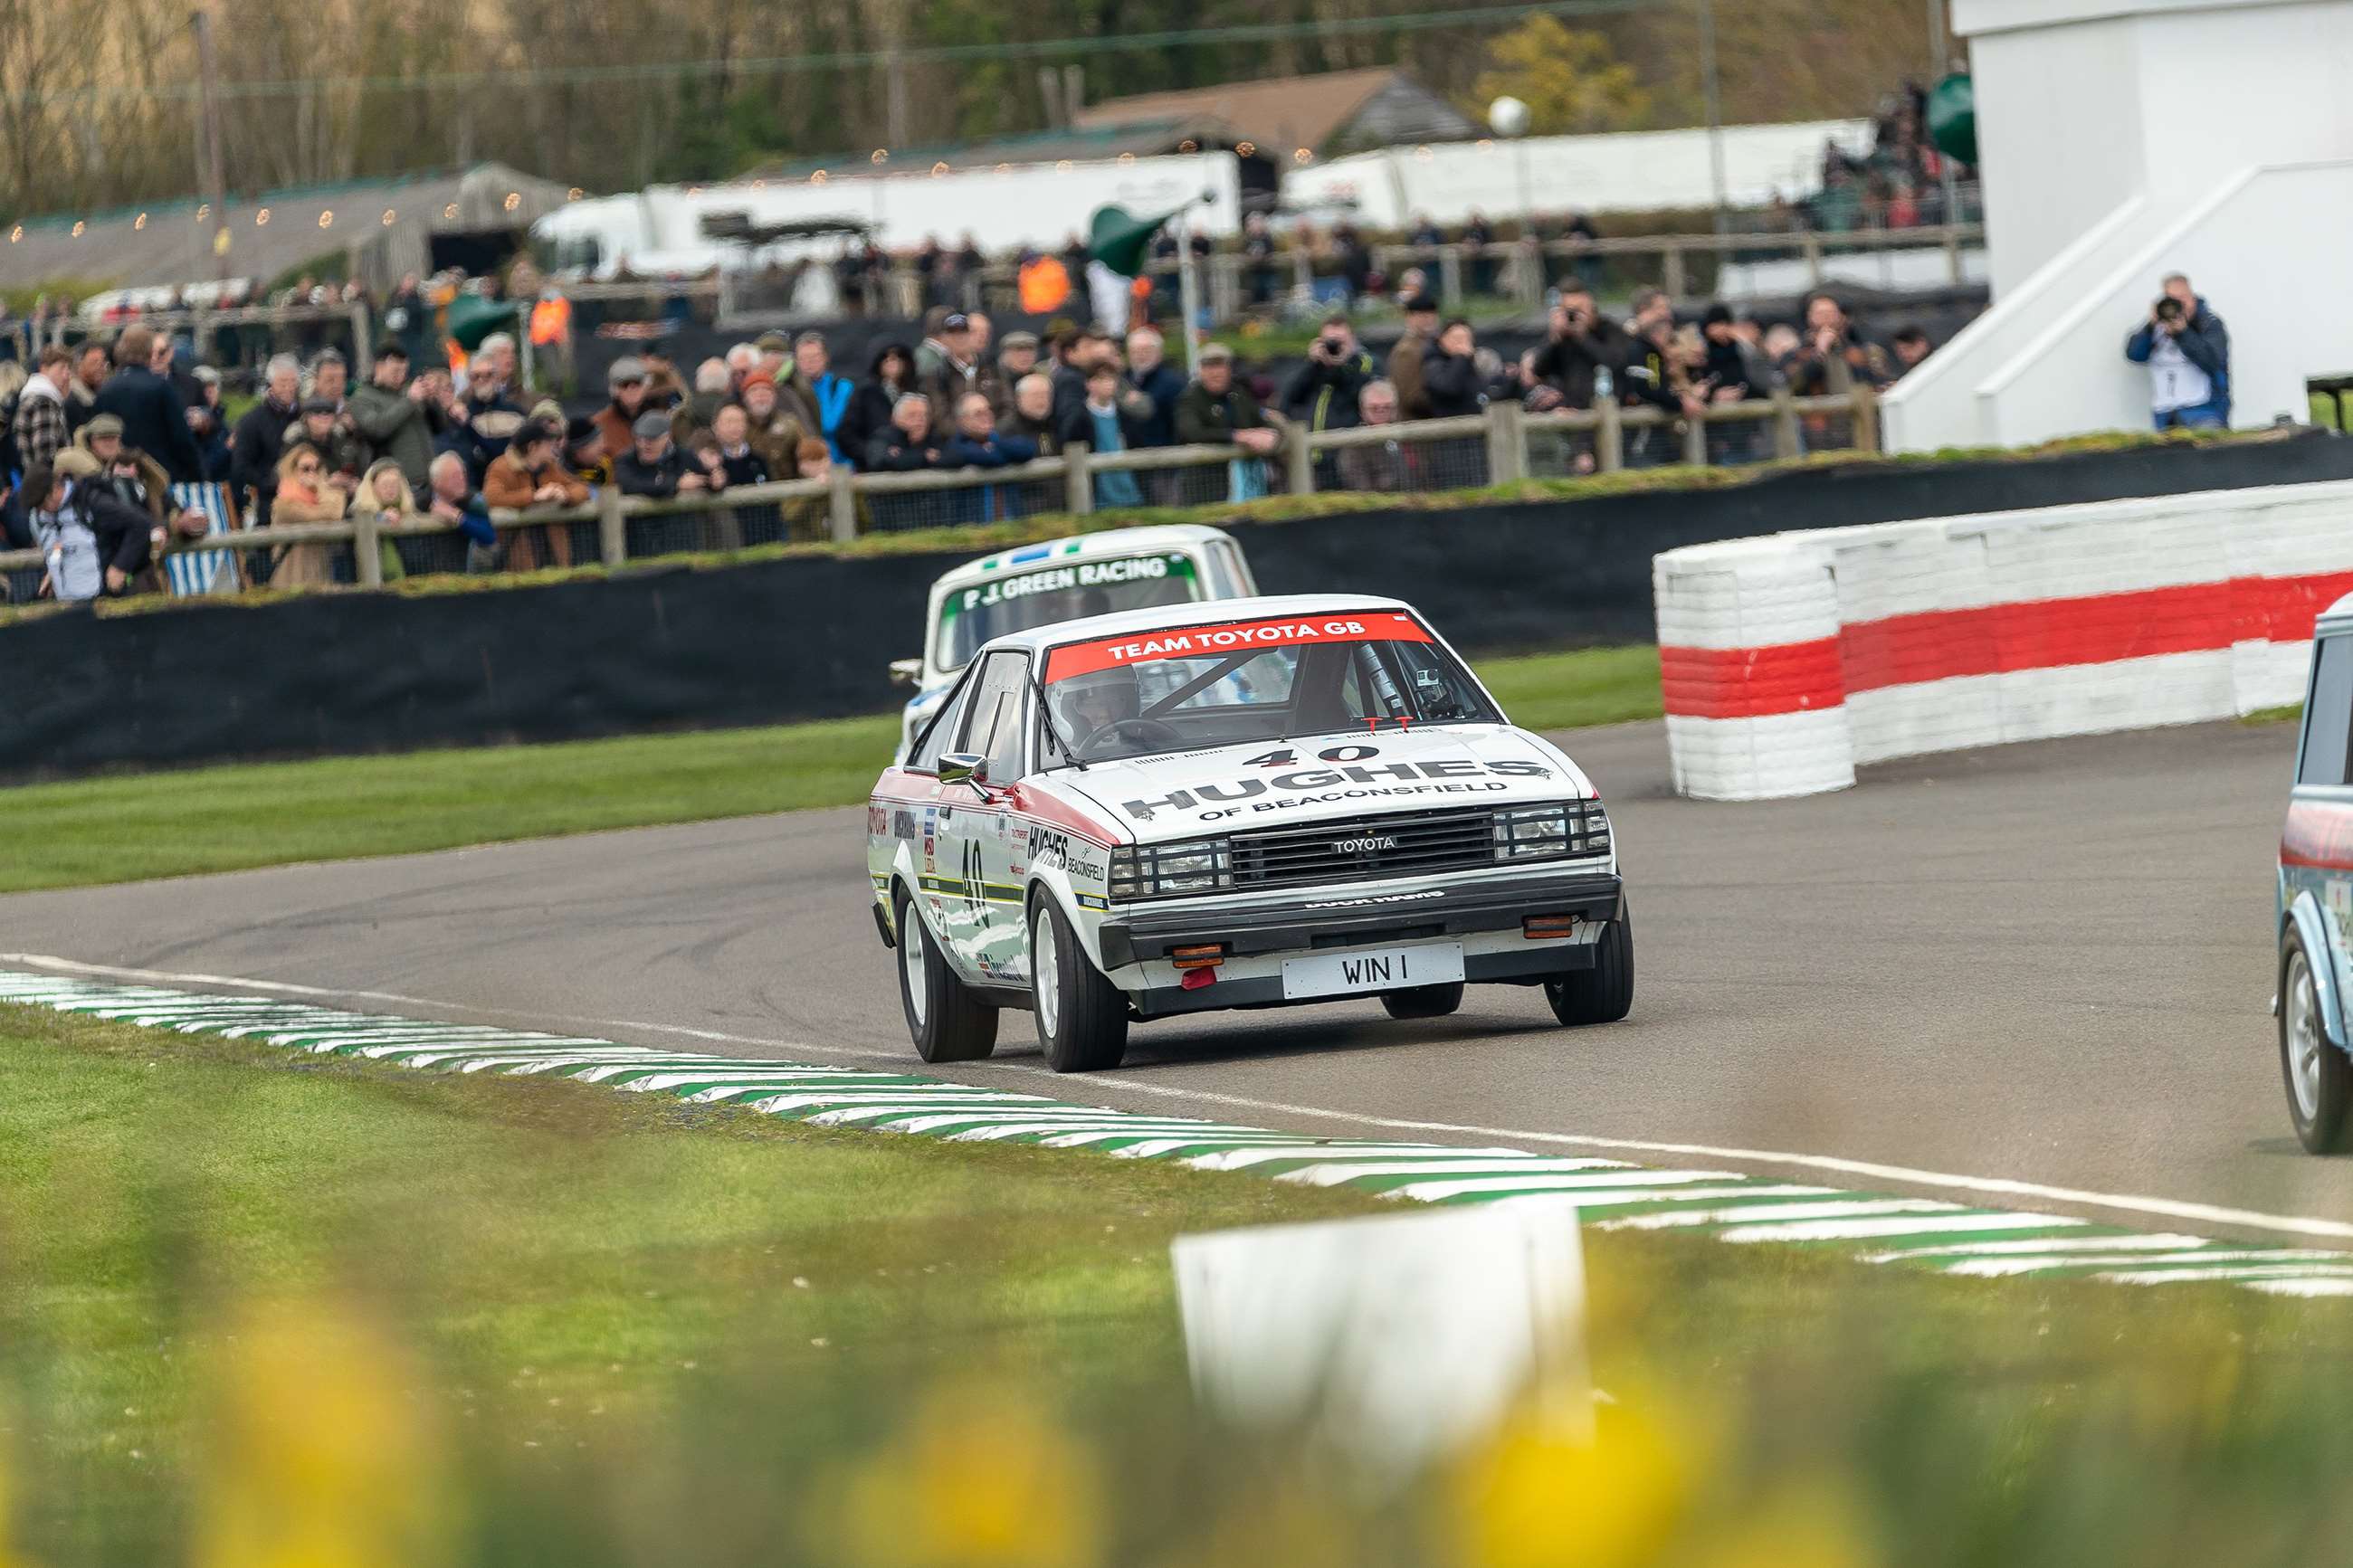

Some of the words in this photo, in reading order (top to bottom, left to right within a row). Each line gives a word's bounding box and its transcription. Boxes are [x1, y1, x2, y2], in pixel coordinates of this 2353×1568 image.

[1002, 567, 1076, 600] GREEN
[1078, 557, 1167, 586] RACING
[1108, 637, 1193, 660] TEAM
[1196, 623, 1320, 647] TOYOTA
[1323, 621, 1367, 635] GB
[1242, 746, 1380, 768] 40
[1121, 761, 1542, 818] HUGHES
[1199, 806, 1243, 822] OF
[1253, 782, 1509, 813] BEACONSFIELD
[1027, 825, 1069, 870] HUGHES
[1333, 836, 1396, 854] TOYOTA
[962, 838, 991, 930] 40
[1067, 857, 1105, 882] BEACONSFIELD
[1342, 956, 1390, 984] WIN
